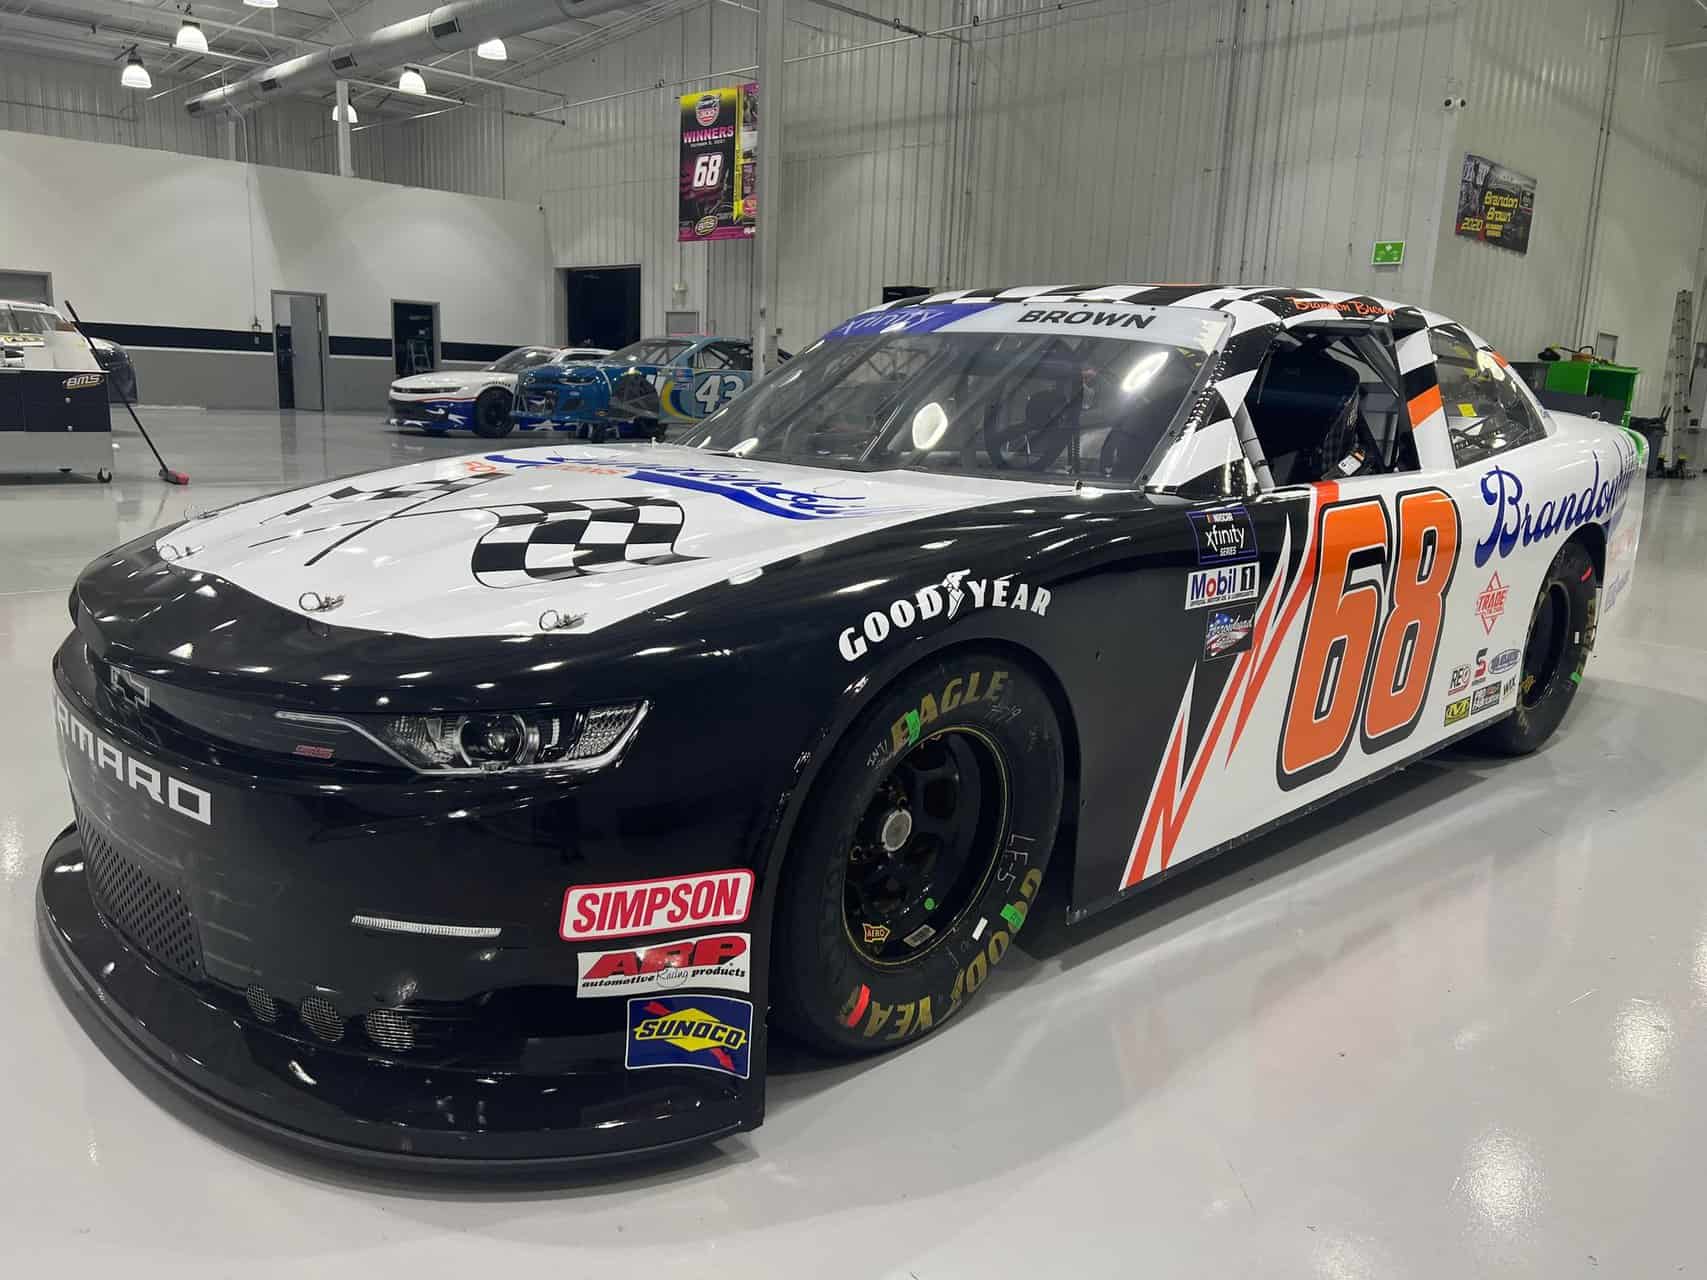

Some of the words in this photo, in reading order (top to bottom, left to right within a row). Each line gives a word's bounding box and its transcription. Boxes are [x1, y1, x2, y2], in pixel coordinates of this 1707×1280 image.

[682, 126, 734, 144] WINNERS
[693, 153, 723, 188] 68
[1017, 310, 1156, 330] BROWN
[695, 375, 745, 414] 43
[1205, 524, 1245, 552] xfinity
[1191, 567, 1237, 601] Mobil
[1276, 487, 1462, 792] 68
[891, 671, 1009, 753] EAGLE
[53, 690, 211, 825] AMARO
[572, 877, 741, 933] SIMPSON
[582, 935, 748, 981] ARP
[581, 974, 655, 988] automotive
[691, 966, 746, 978] products
[638, 1018, 744, 1048] SUNOCO
